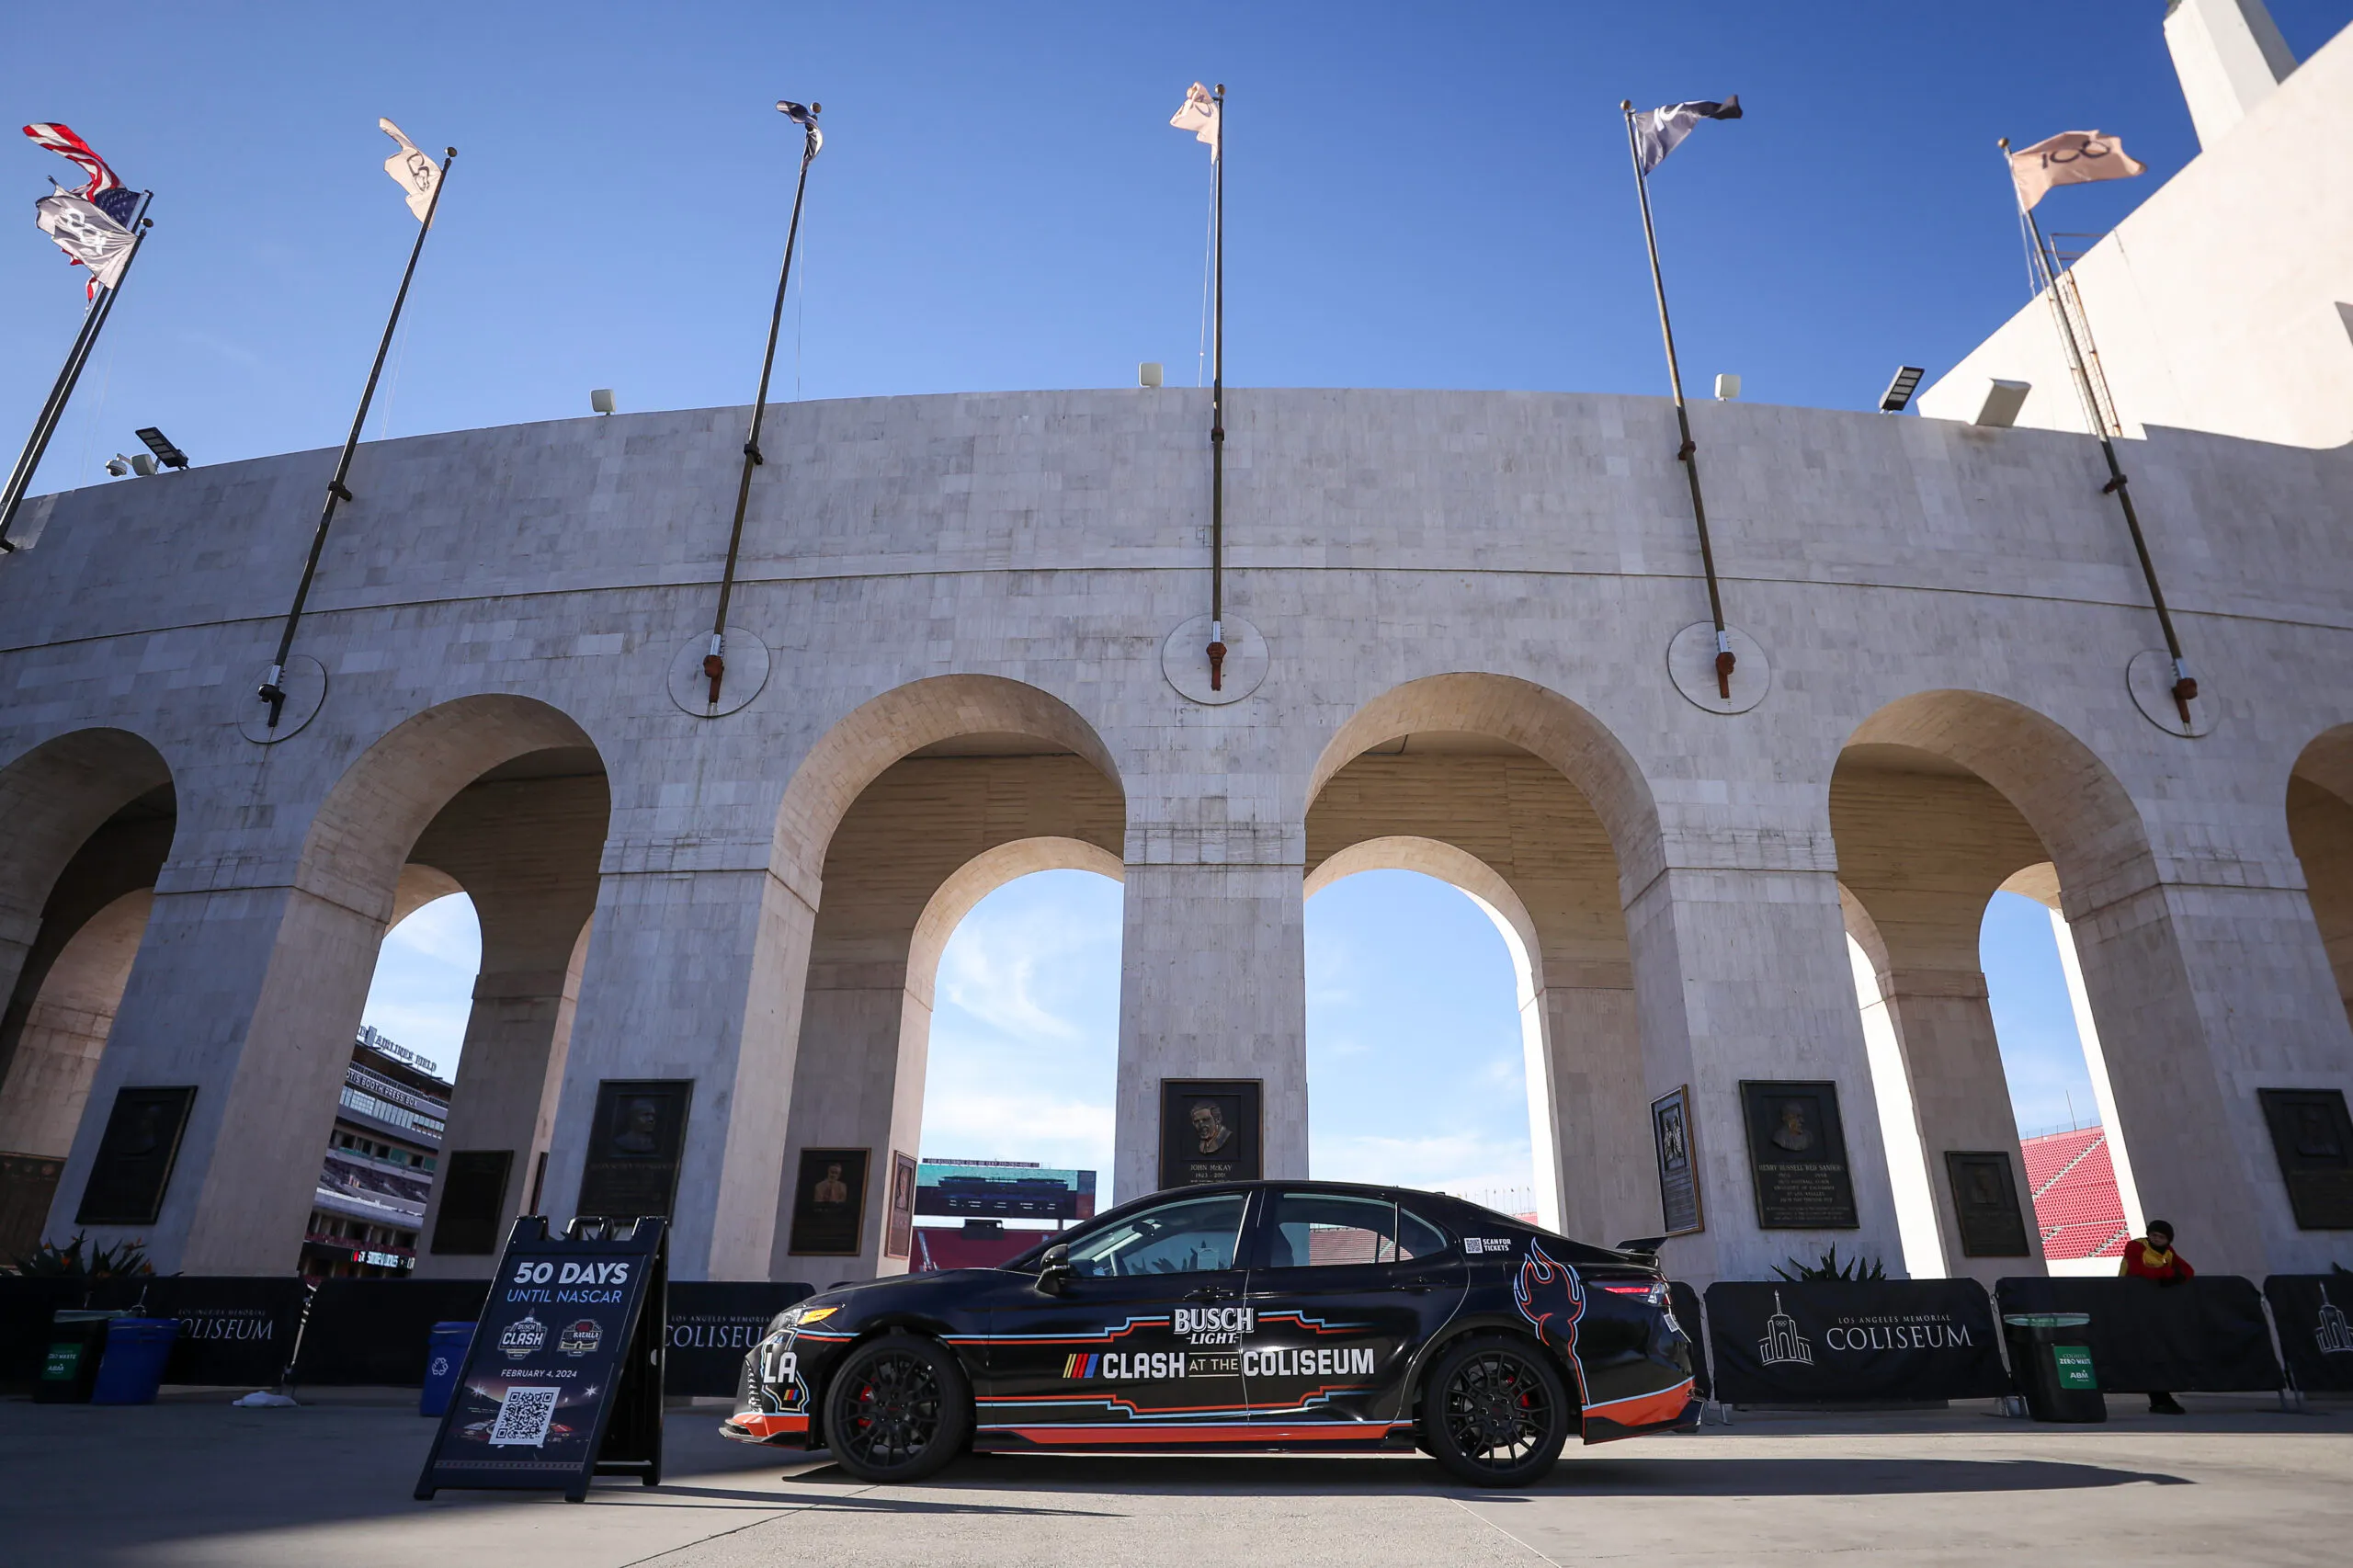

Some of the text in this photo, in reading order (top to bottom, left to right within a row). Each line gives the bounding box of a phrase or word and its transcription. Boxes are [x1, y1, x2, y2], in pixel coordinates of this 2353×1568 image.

[375, 1035, 438, 1073] AIRLINES FIELD
[361, 1076, 383, 1095] BOOTH
[384, 1087, 404, 1103] PRESS
[405, 1095, 418, 1108] BOX
[513, 1262, 630, 1285] 50 DAYS
[506, 1290, 622, 1303] UNTIL NASCAR
[171, 1318, 273, 1340] OLISEUM
[671, 1314, 687, 1323] LOS
[690, 1314, 726, 1323] ANGELES
[1174, 1307, 1255, 1335] BUSCH
[1859, 1315, 1899, 1324] ANGELES
[1903, 1314, 1951, 1323] MEMORIAL
[502, 1333, 544, 1345] CLASH
[665, 1325, 764, 1348] COLISEU
[1826, 1324, 1973, 1351] COLISEUM
[501, 1369, 545, 1378] FEBRUARY
[555, 1369, 577, 1378] 2024
[763, 1352, 798, 1383] LA
[1103, 1348, 1375, 1379] CLASH AT THE COLISEUM
